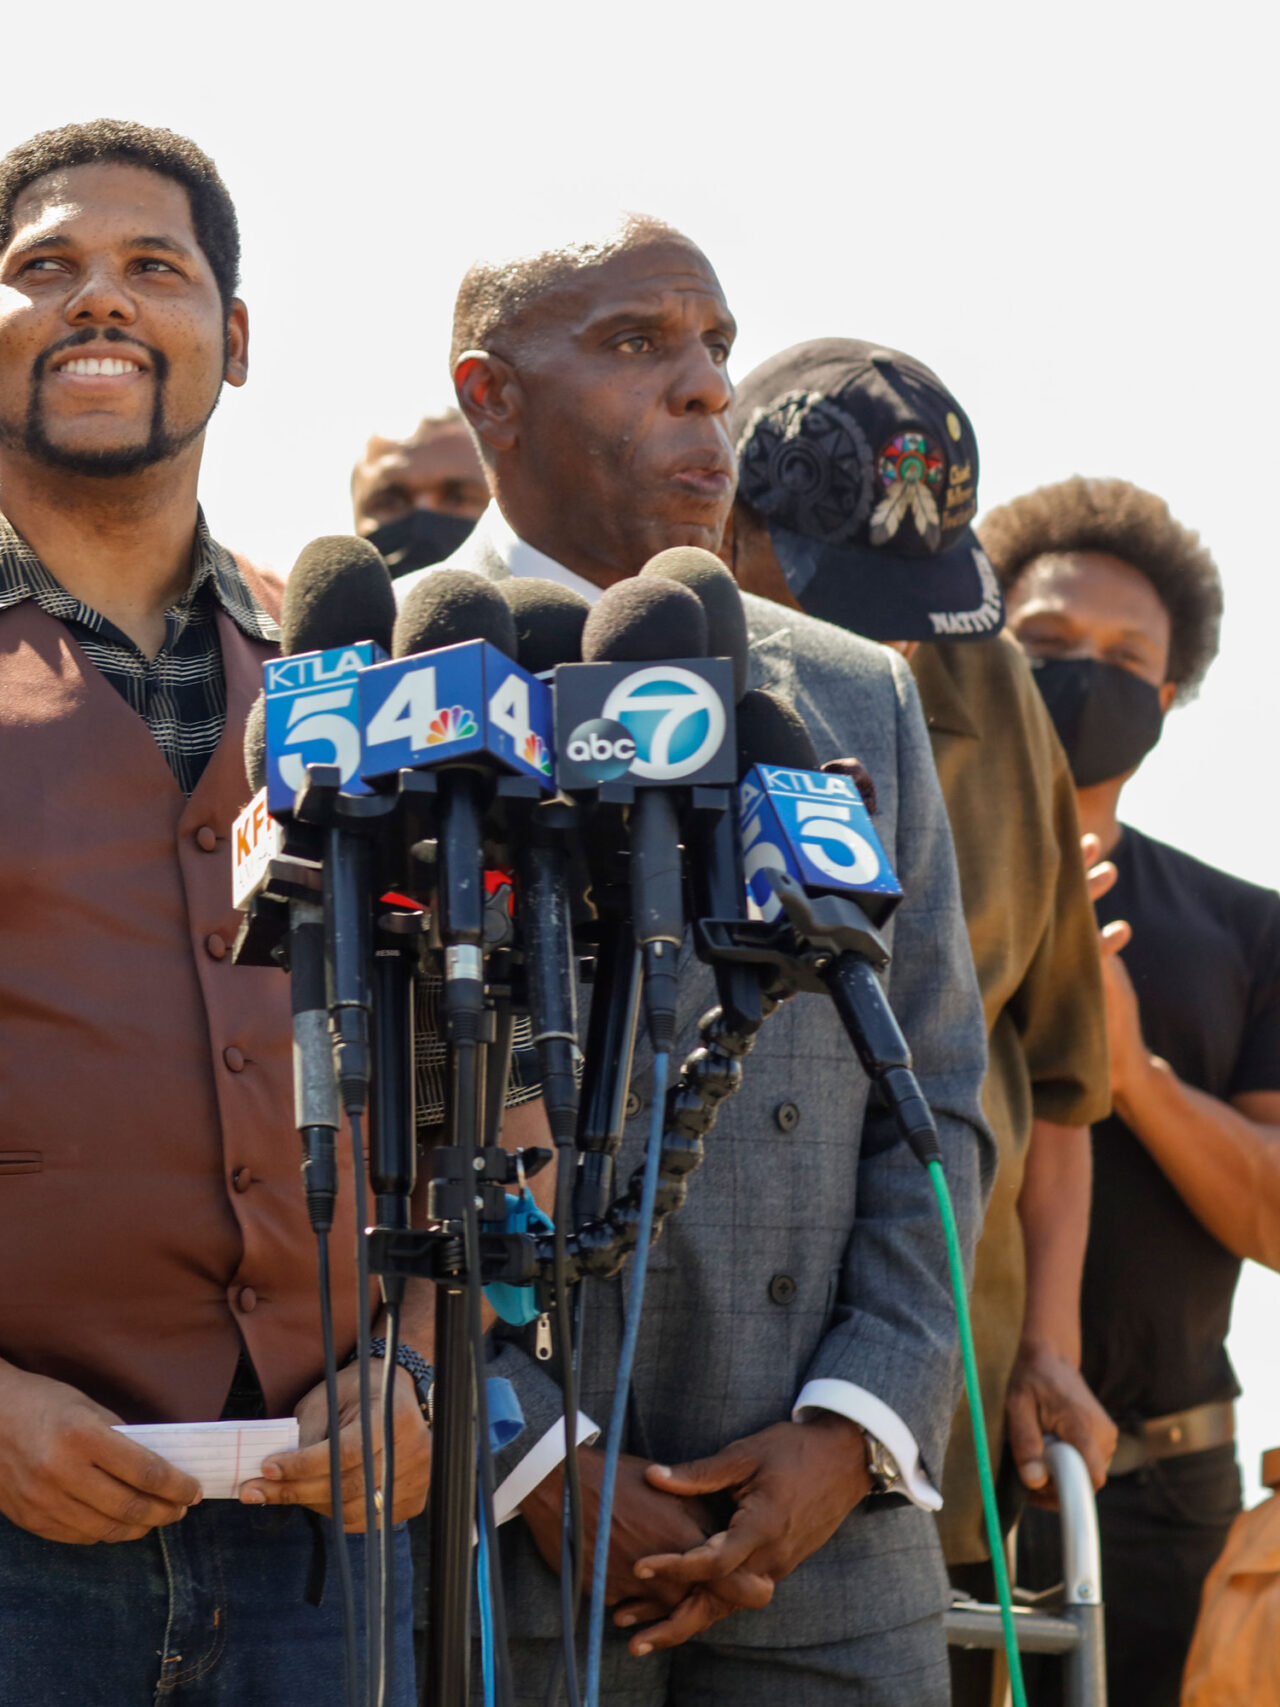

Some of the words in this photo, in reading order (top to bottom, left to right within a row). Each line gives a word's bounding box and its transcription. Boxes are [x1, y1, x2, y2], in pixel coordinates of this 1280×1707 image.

[268, 649, 365, 691] KTLA
[366, 666, 437, 752] 4
[278, 687, 361, 793] 5
[489, 673, 530, 758] 4
[566, 733, 637, 763] abc
[611, 690, 714, 768] 7
[762, 767, 857, 799] KTLA
[795, 800, 880, 885] 5
